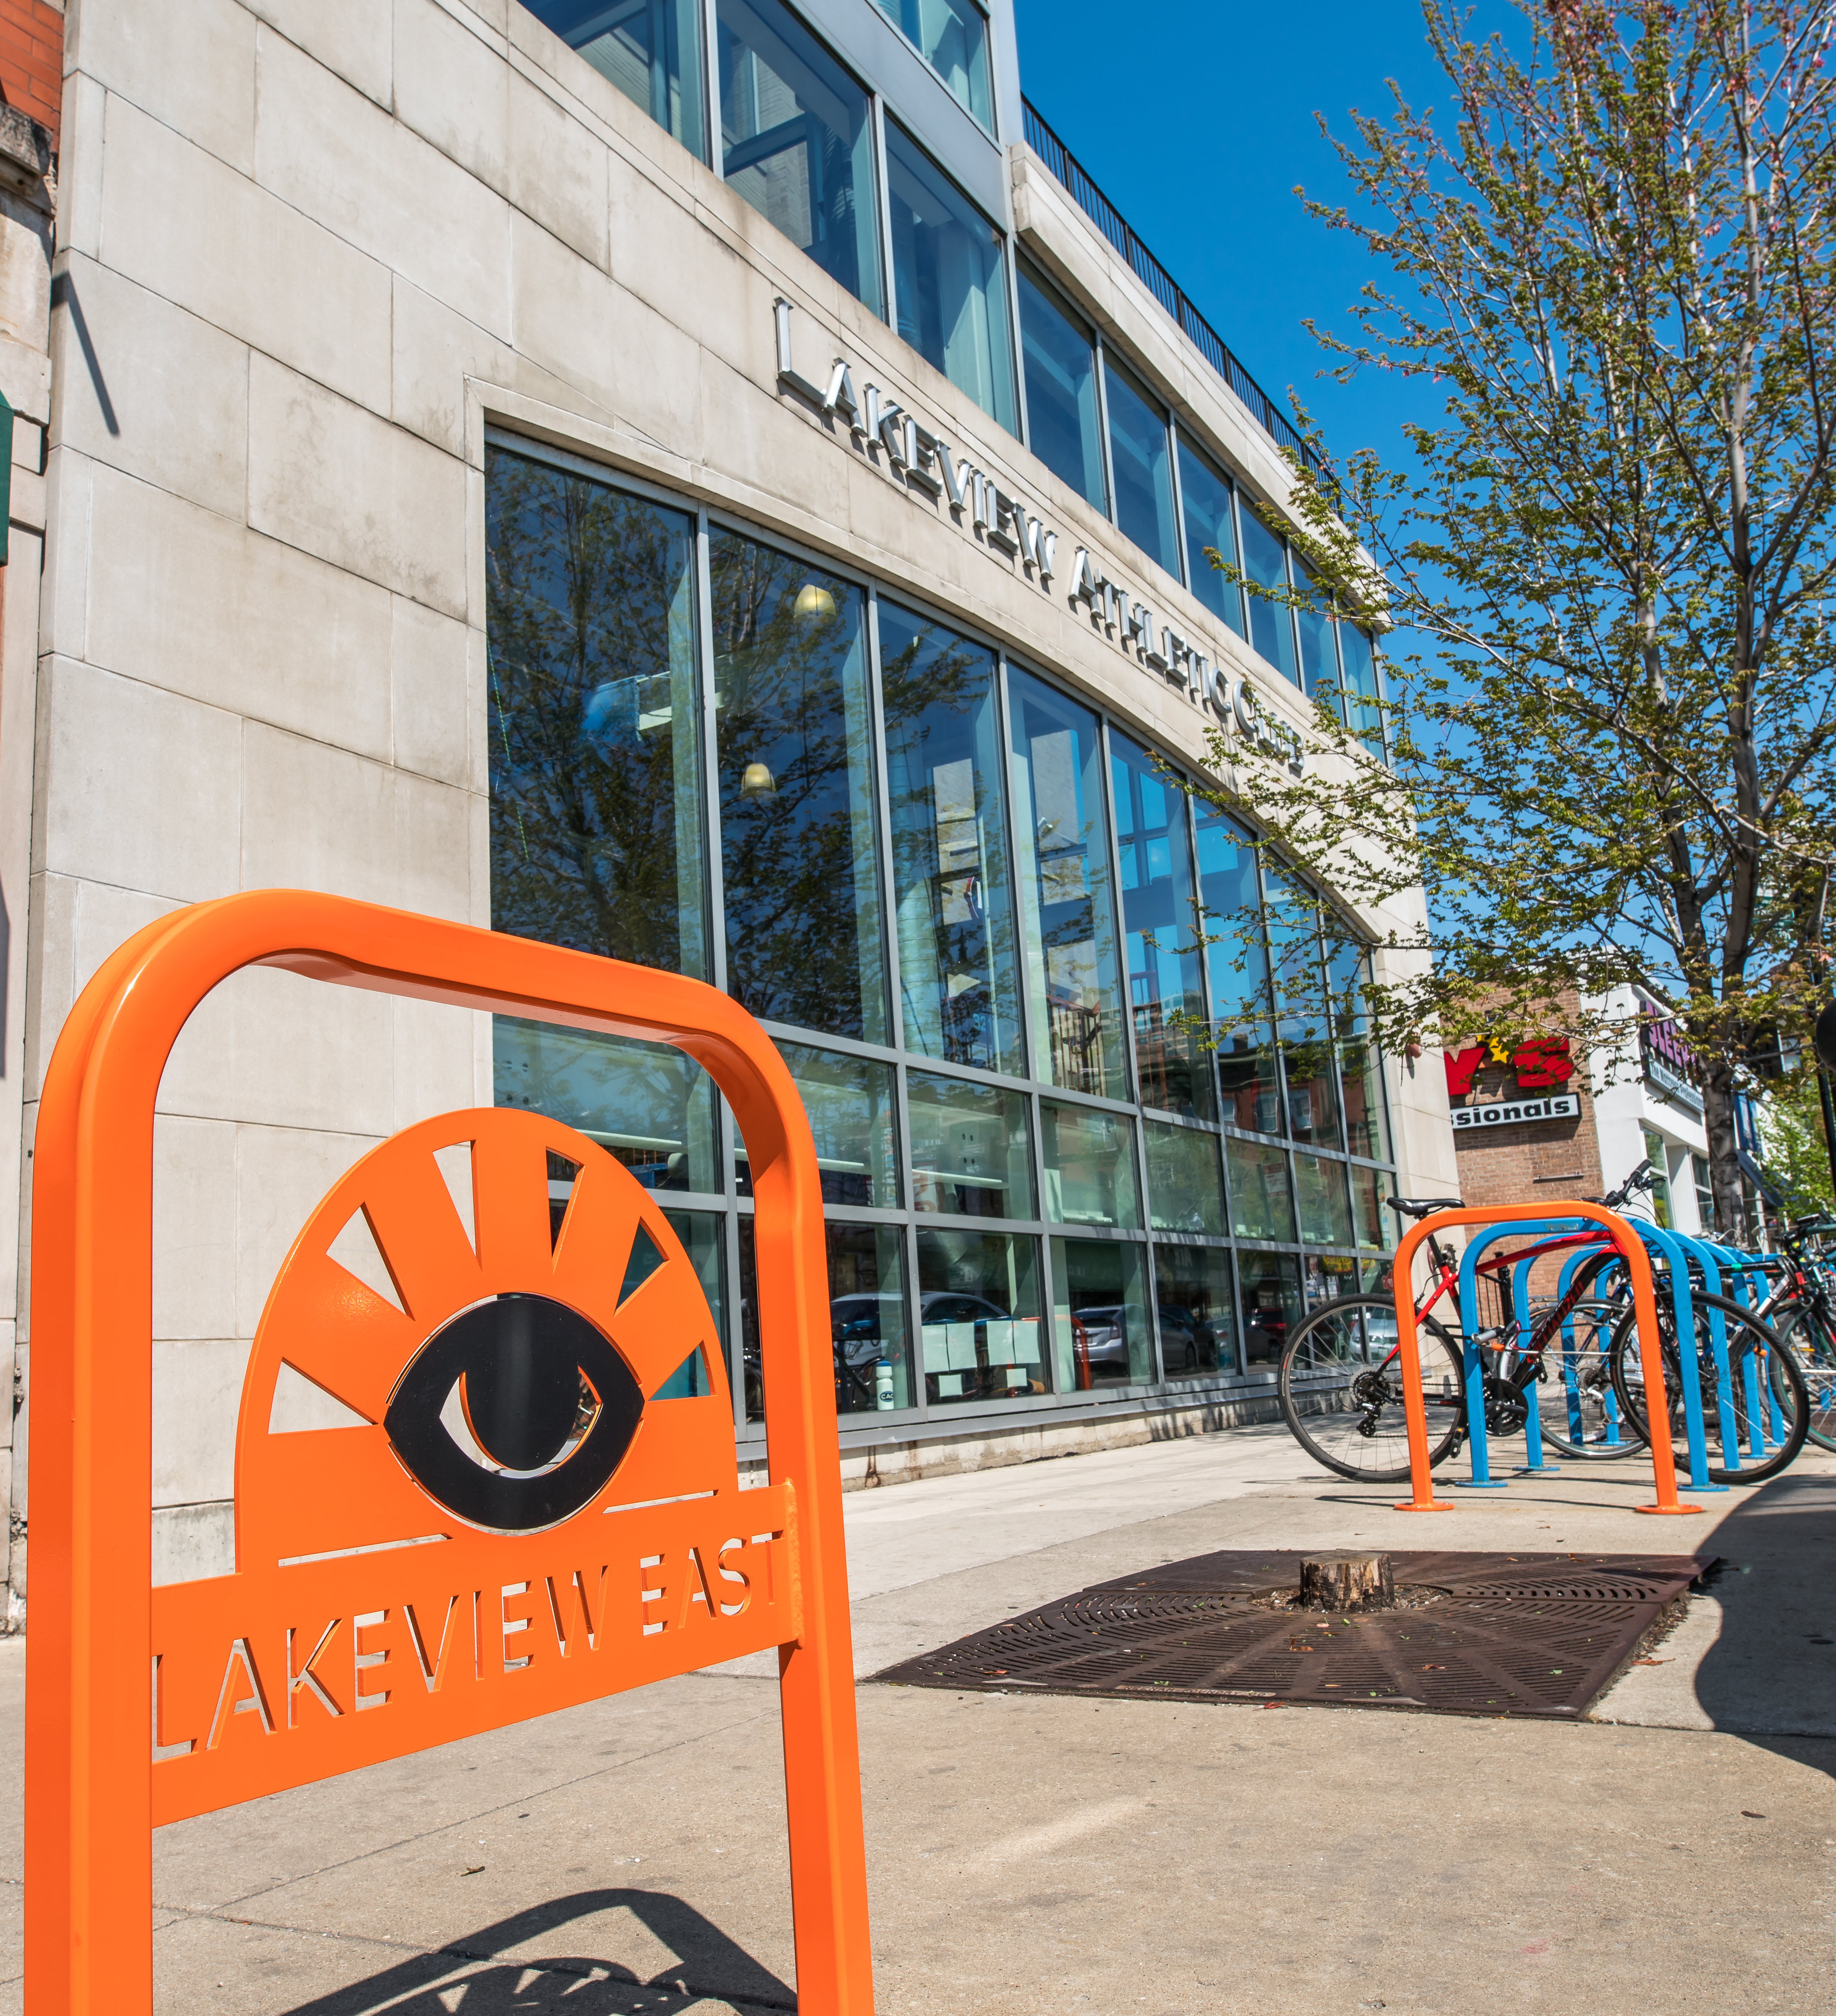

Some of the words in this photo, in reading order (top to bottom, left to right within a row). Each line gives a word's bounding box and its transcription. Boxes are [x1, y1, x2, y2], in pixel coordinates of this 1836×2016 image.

[774, 296, 1059, 580] LAKEVIEW
[1068, 545, 1232, 714] ATHLETIC
[1233, 680, 1305, 772] CLUB
[1450, 1100, 1570, 1126] sionals
[151, 1565, 609, 1764] LAKEVIEW
[640, 1530, 785, 1638] EAST
